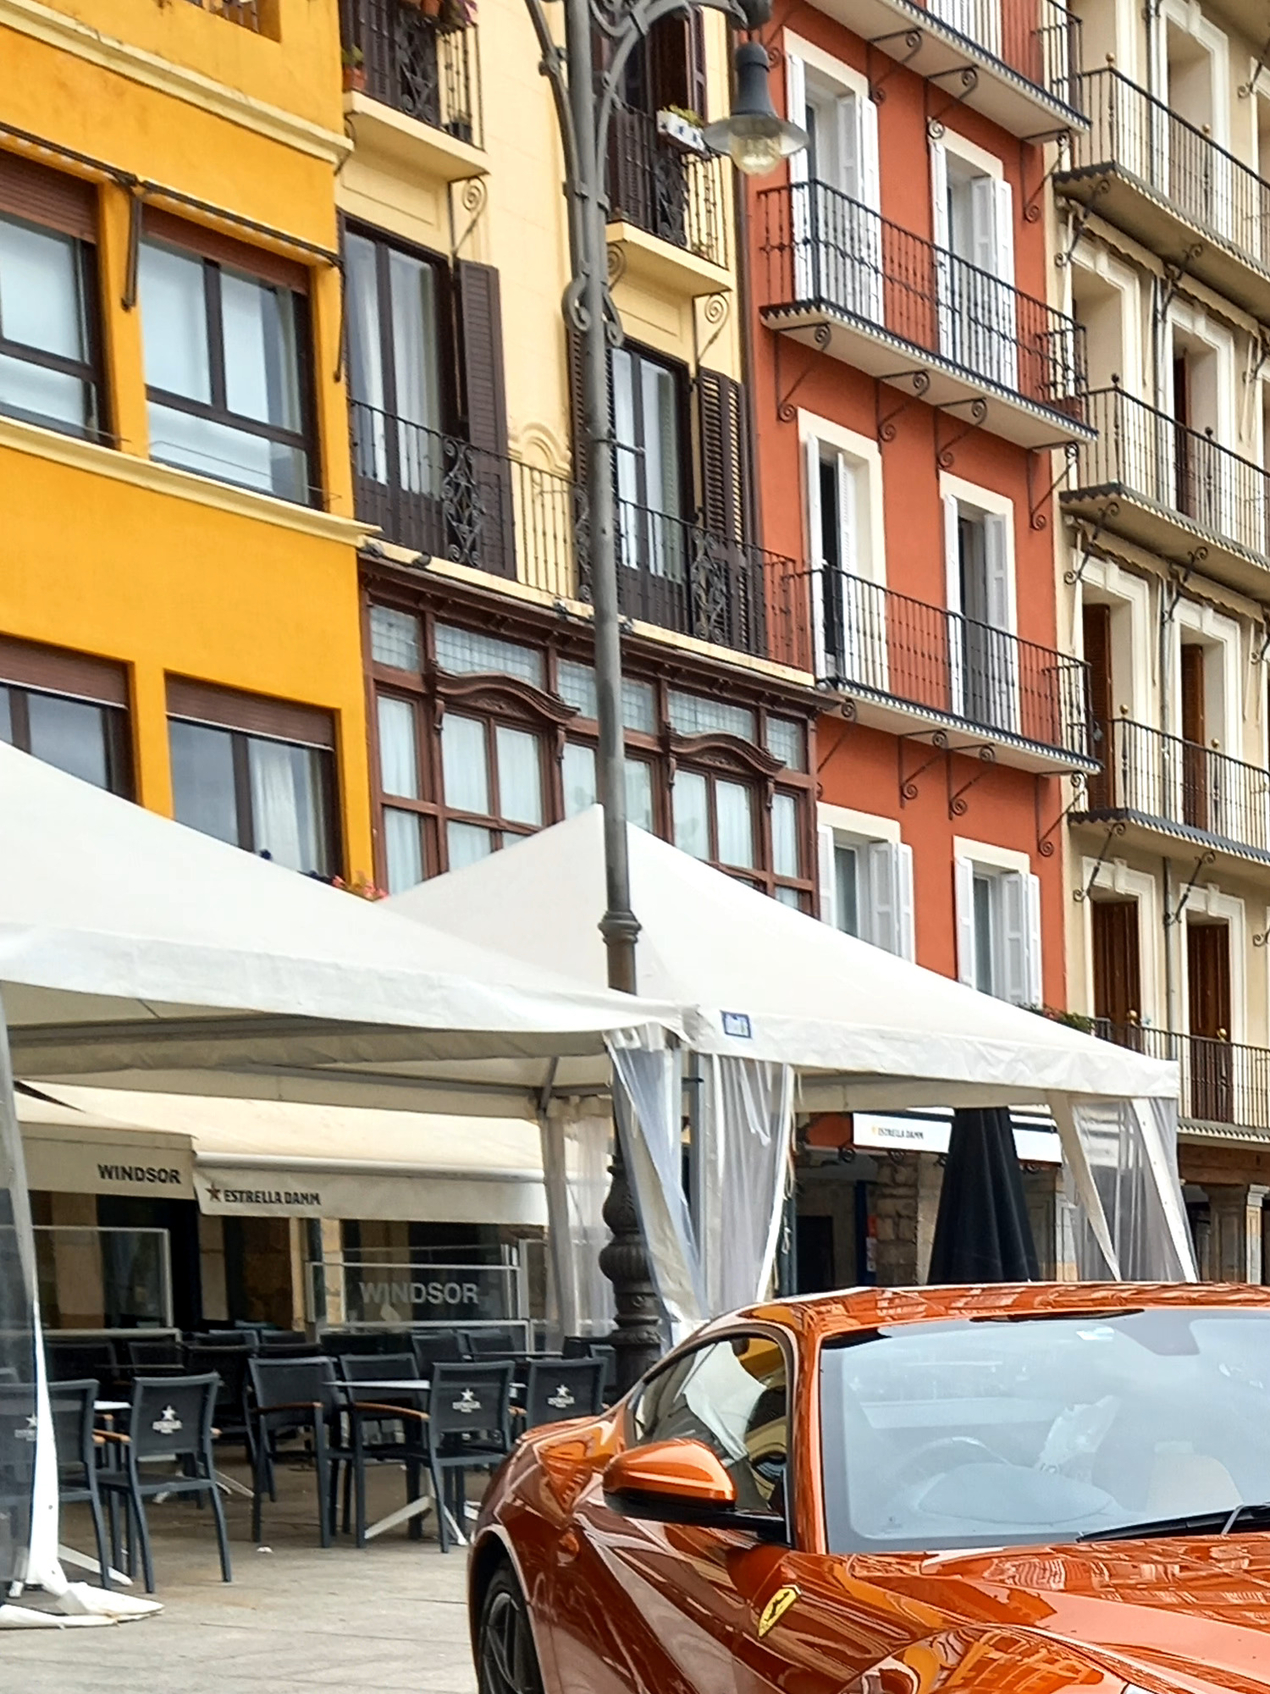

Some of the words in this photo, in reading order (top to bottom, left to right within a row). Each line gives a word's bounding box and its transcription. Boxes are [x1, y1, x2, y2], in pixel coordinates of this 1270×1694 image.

[97, 1163, 182, 1185] WINDSOR
[223, 1190, 283, 1205] ESTRELLA
[285, 1191, 322, 1206] DAMM
[358, 1281, 479, 1305] WINDSOR
